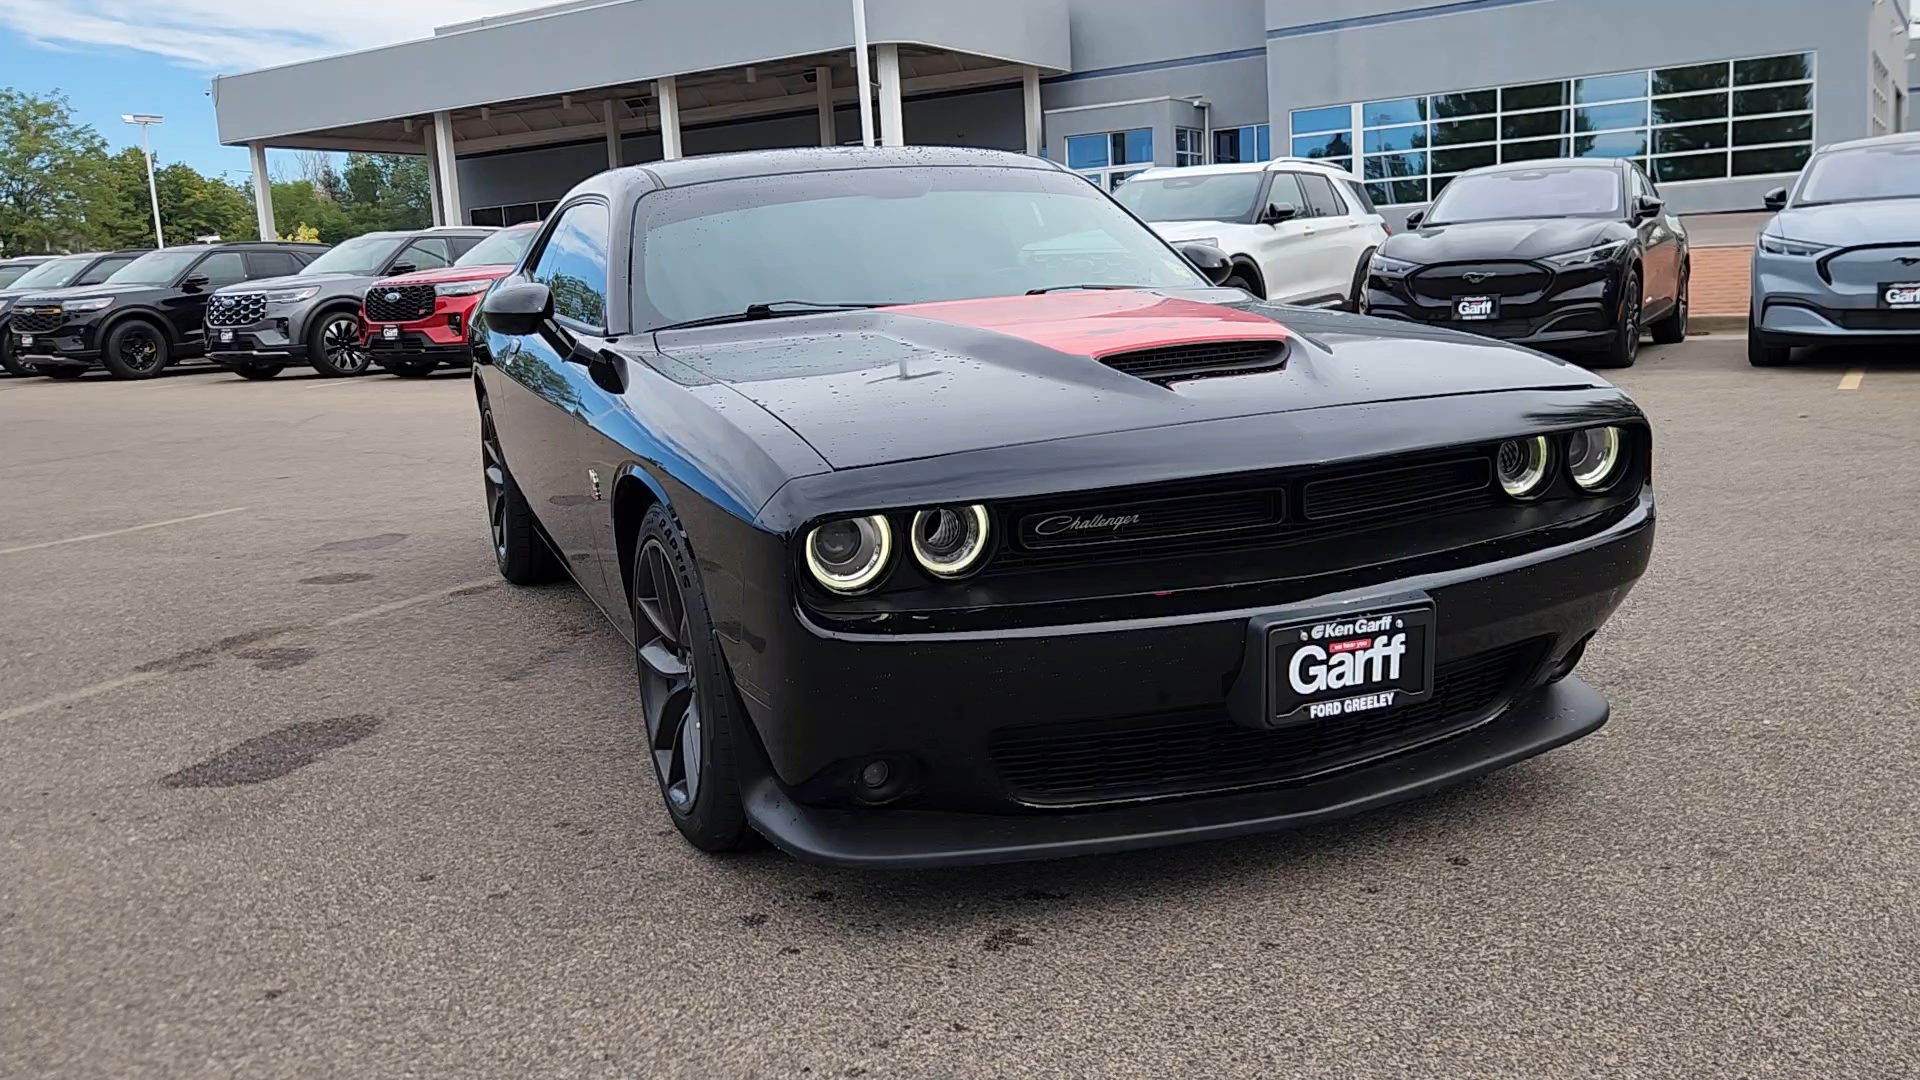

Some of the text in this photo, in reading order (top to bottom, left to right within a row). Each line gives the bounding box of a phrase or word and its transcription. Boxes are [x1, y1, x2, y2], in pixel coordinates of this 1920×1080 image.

[1458, 301, 1492, 315] Garff
[1035, 514, 1140, 535] Challenger
[1324, 616, 1392, 638] Ken Garff
[1288, 633, 1406, 695] Garff
[1310, 693, 1395, 719] FORD GREELEY
